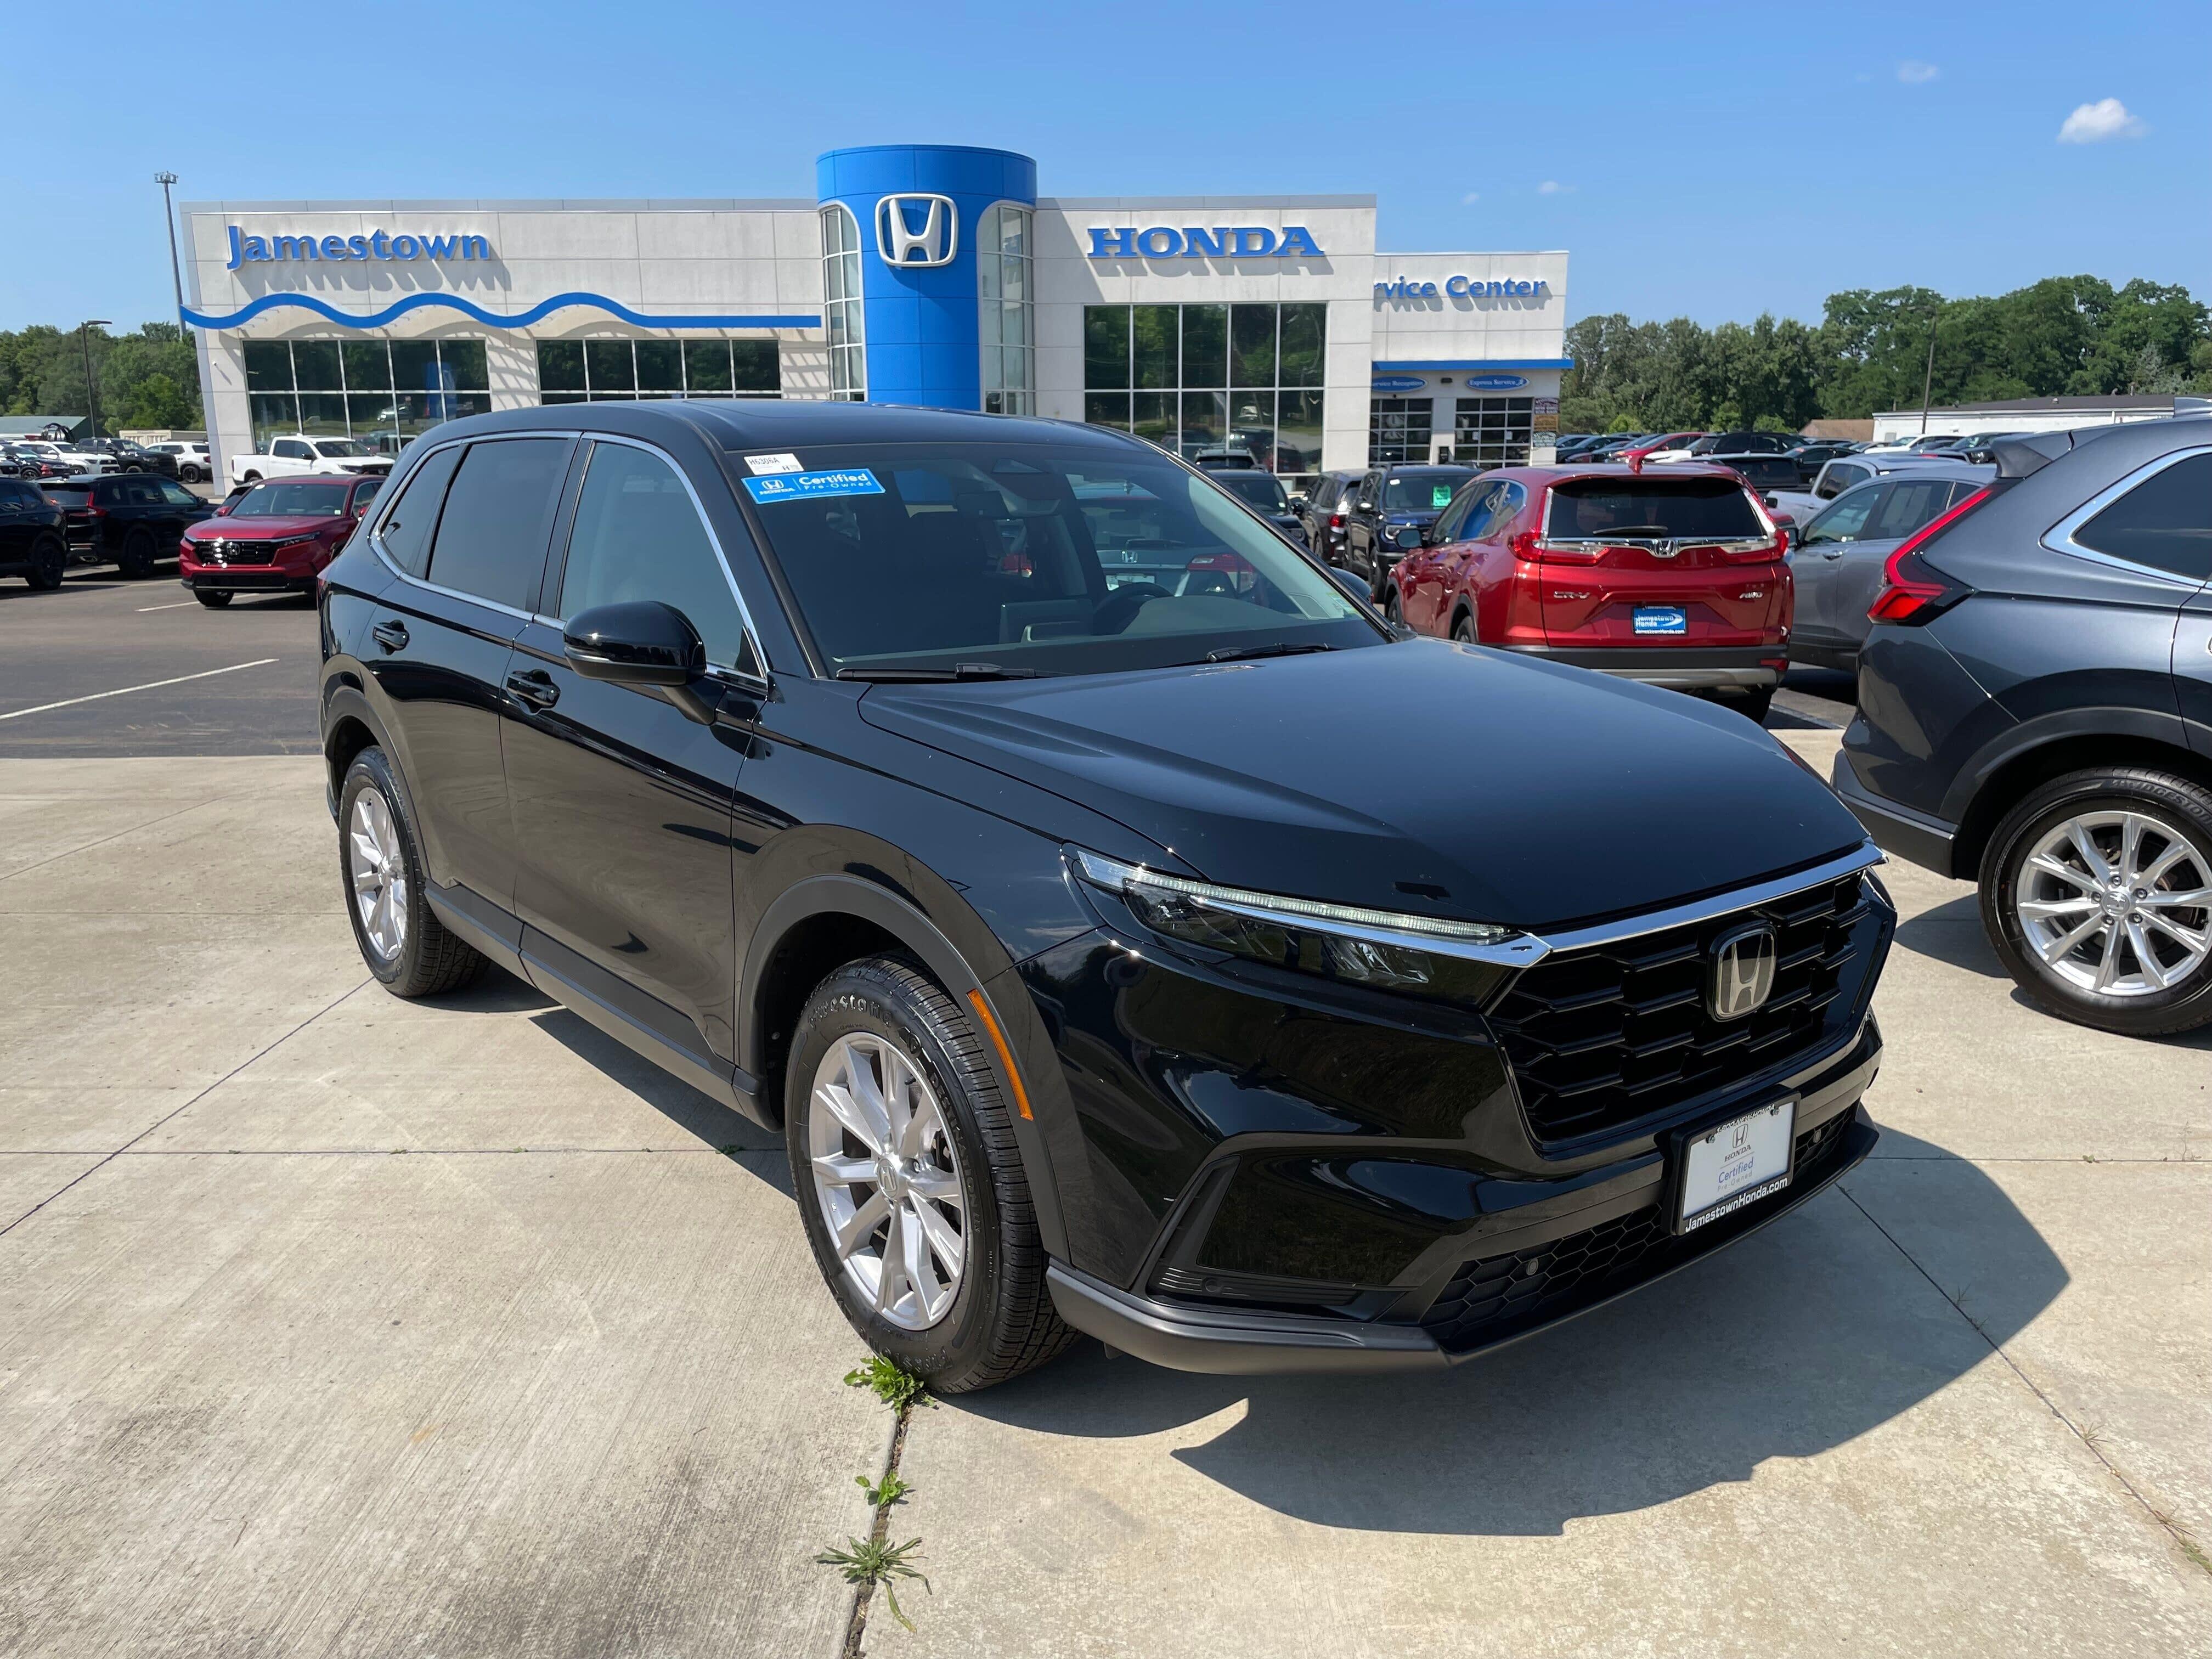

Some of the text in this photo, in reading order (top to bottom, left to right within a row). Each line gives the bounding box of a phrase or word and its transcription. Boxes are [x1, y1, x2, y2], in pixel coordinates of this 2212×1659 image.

[227, 225, 490, 270] Jamestown
[1087, 227, 1325, 258] HONDA
[1374, 275, 1547, 298] rvice Center
[799, 473, 868, 485] Certified
[804, 481, 872, 490] Pre-Owned
[1724, 1144, 1752, 1163] HONDA
[1718, 1156, 1754, 1183] Certified
[1685, 1177, 1788, 1233] JamestownHonda.com
